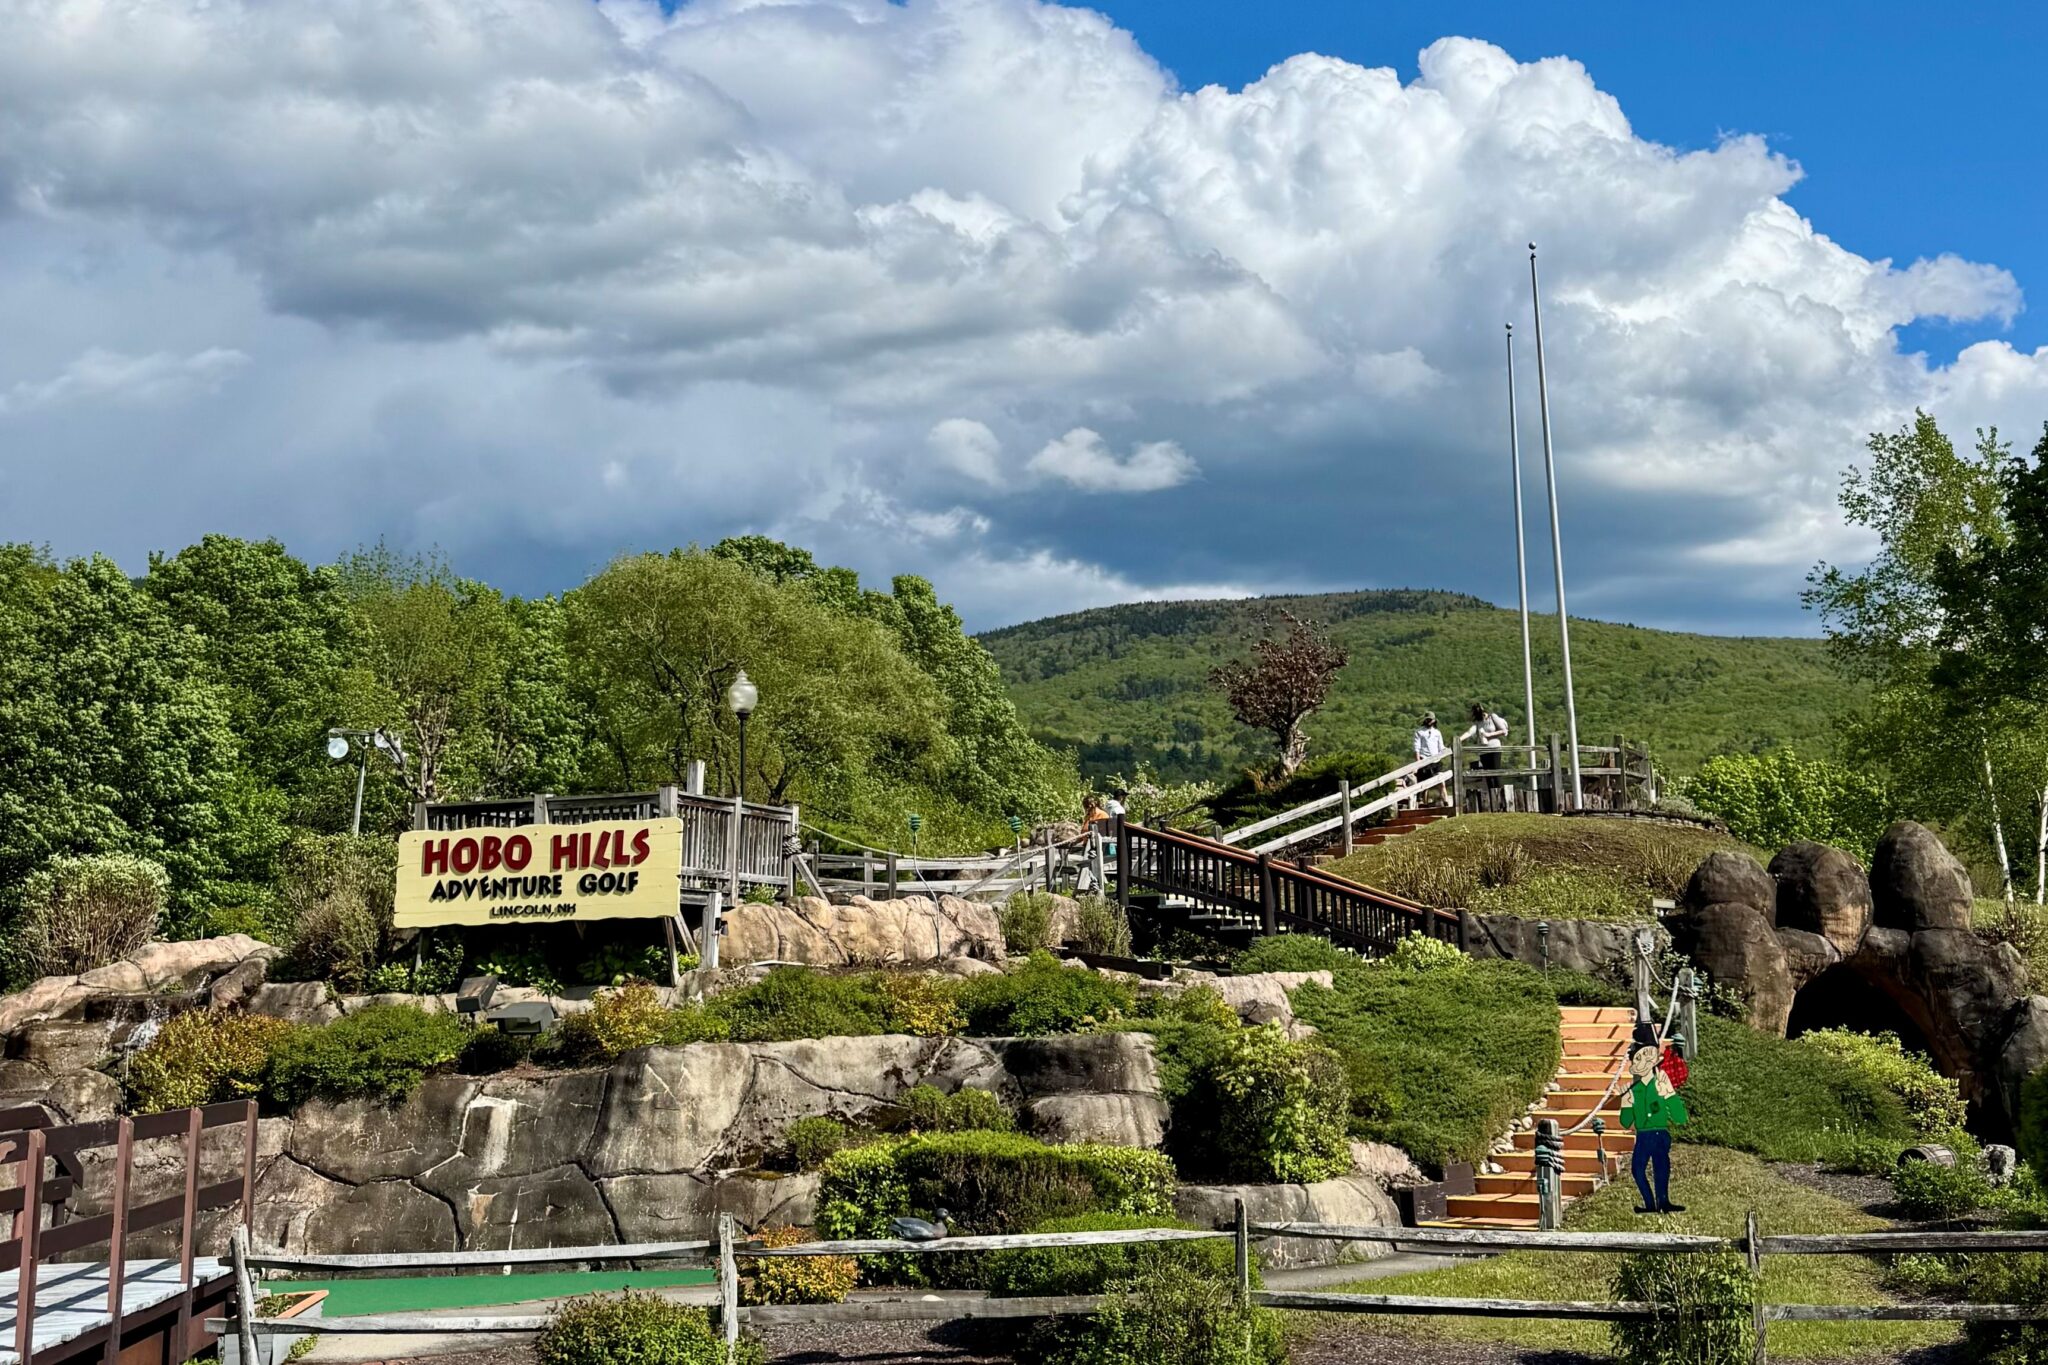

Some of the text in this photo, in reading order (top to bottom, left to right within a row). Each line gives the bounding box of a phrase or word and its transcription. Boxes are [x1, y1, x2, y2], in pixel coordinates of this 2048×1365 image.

[422, 829, 650, 875] HOBO HILLS
[430, 871, 639, 901] ADVENTURE GOLF
[489, 903, 576, 918] LINCOLN, NH
